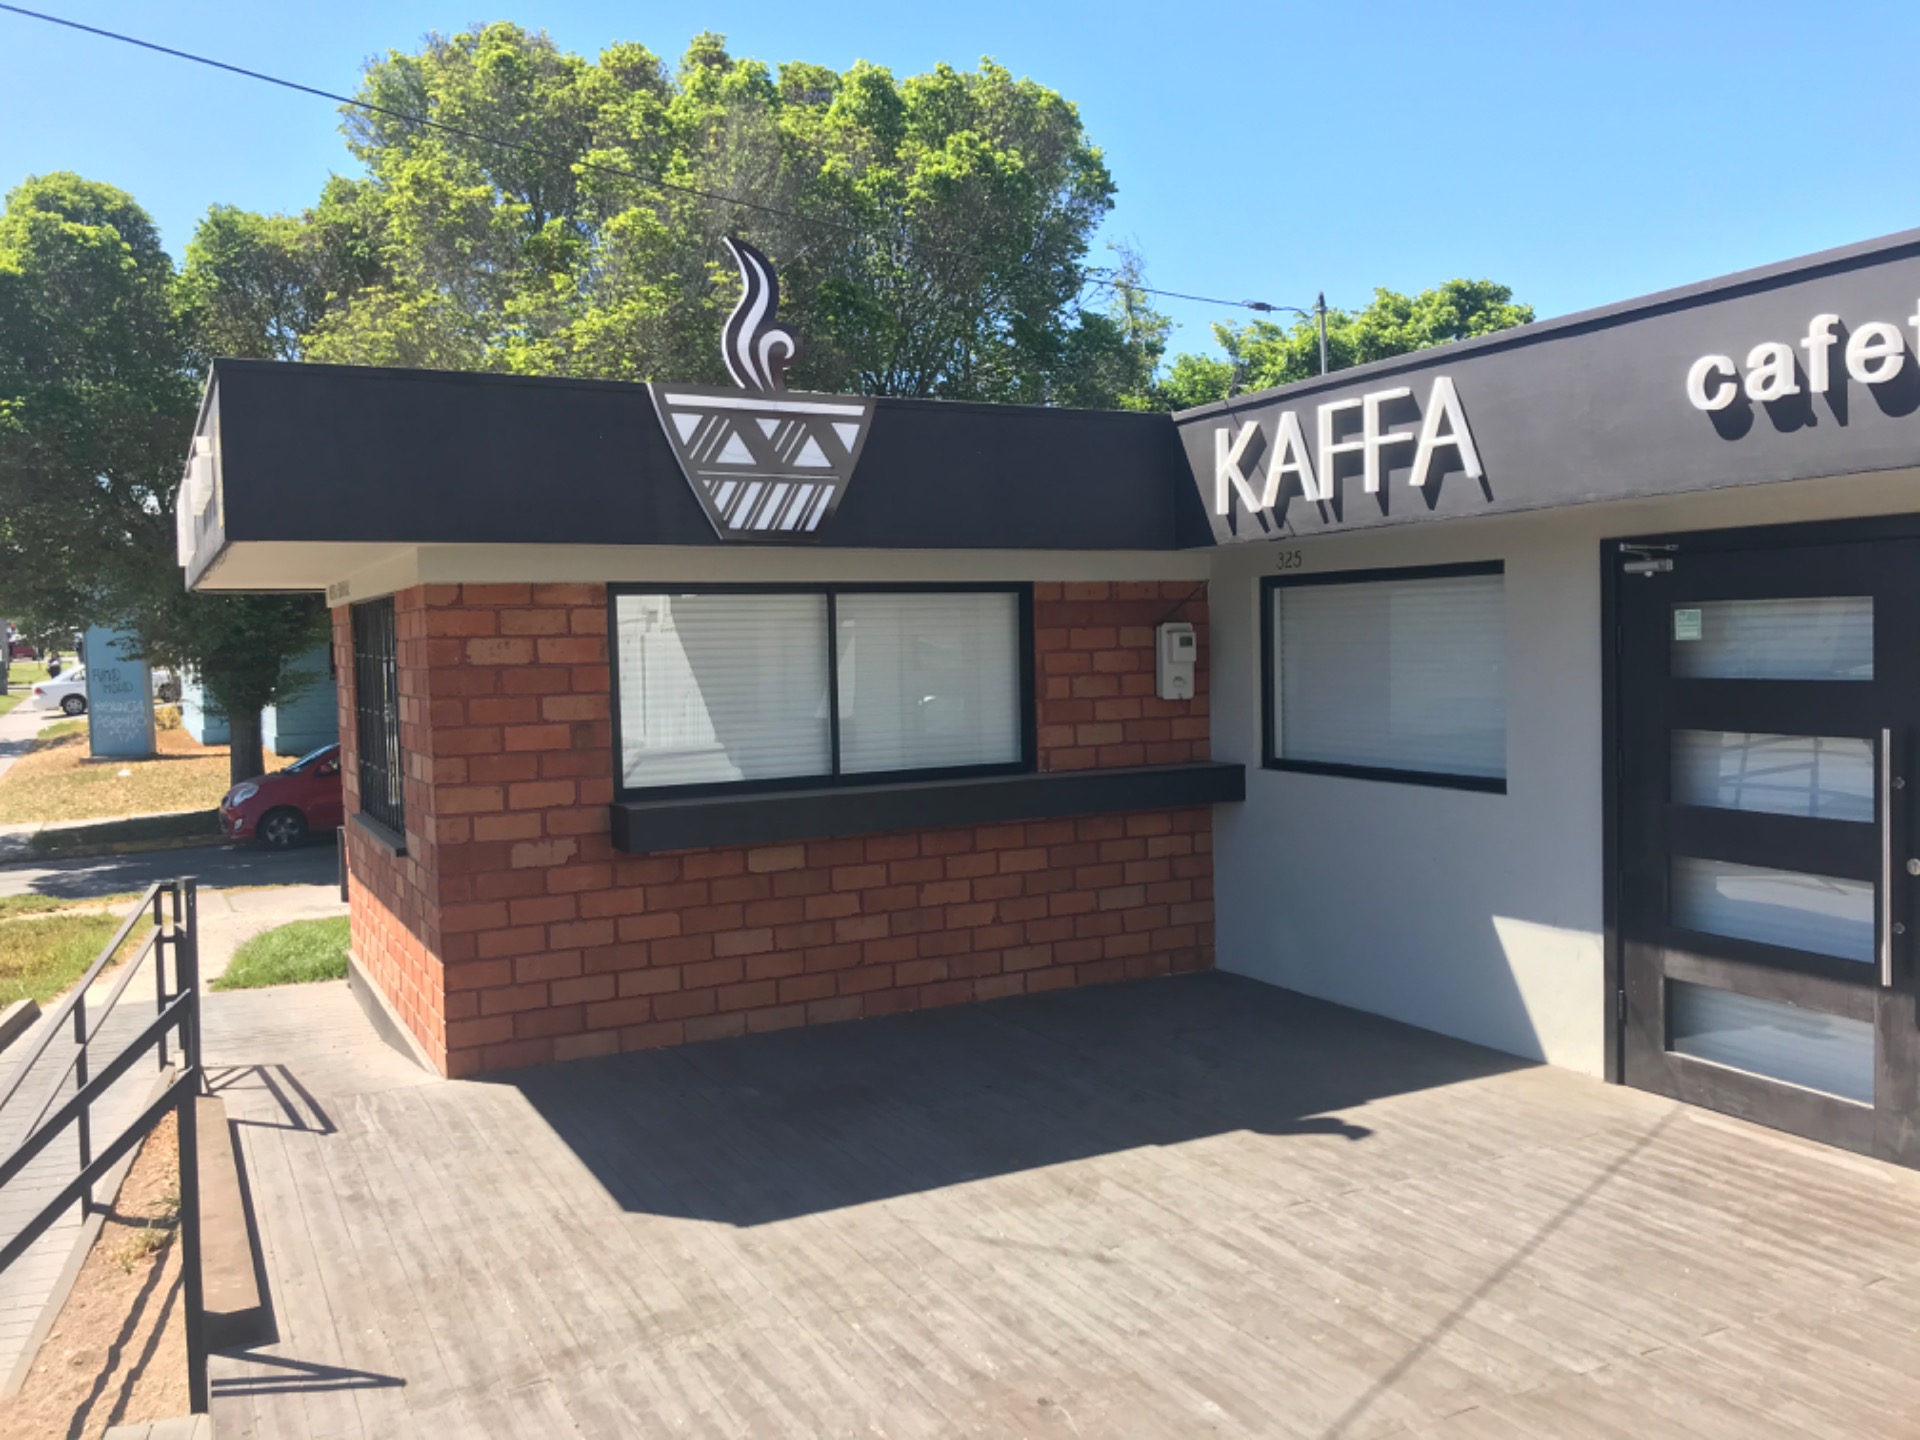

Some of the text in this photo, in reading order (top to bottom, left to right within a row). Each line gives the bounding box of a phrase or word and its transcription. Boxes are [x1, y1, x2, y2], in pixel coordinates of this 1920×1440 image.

[1687, 297, 1920, 411] cafe
[1215, 376, 1482, 515] KAFFA
[1276, 550, 1302, 570] 325
